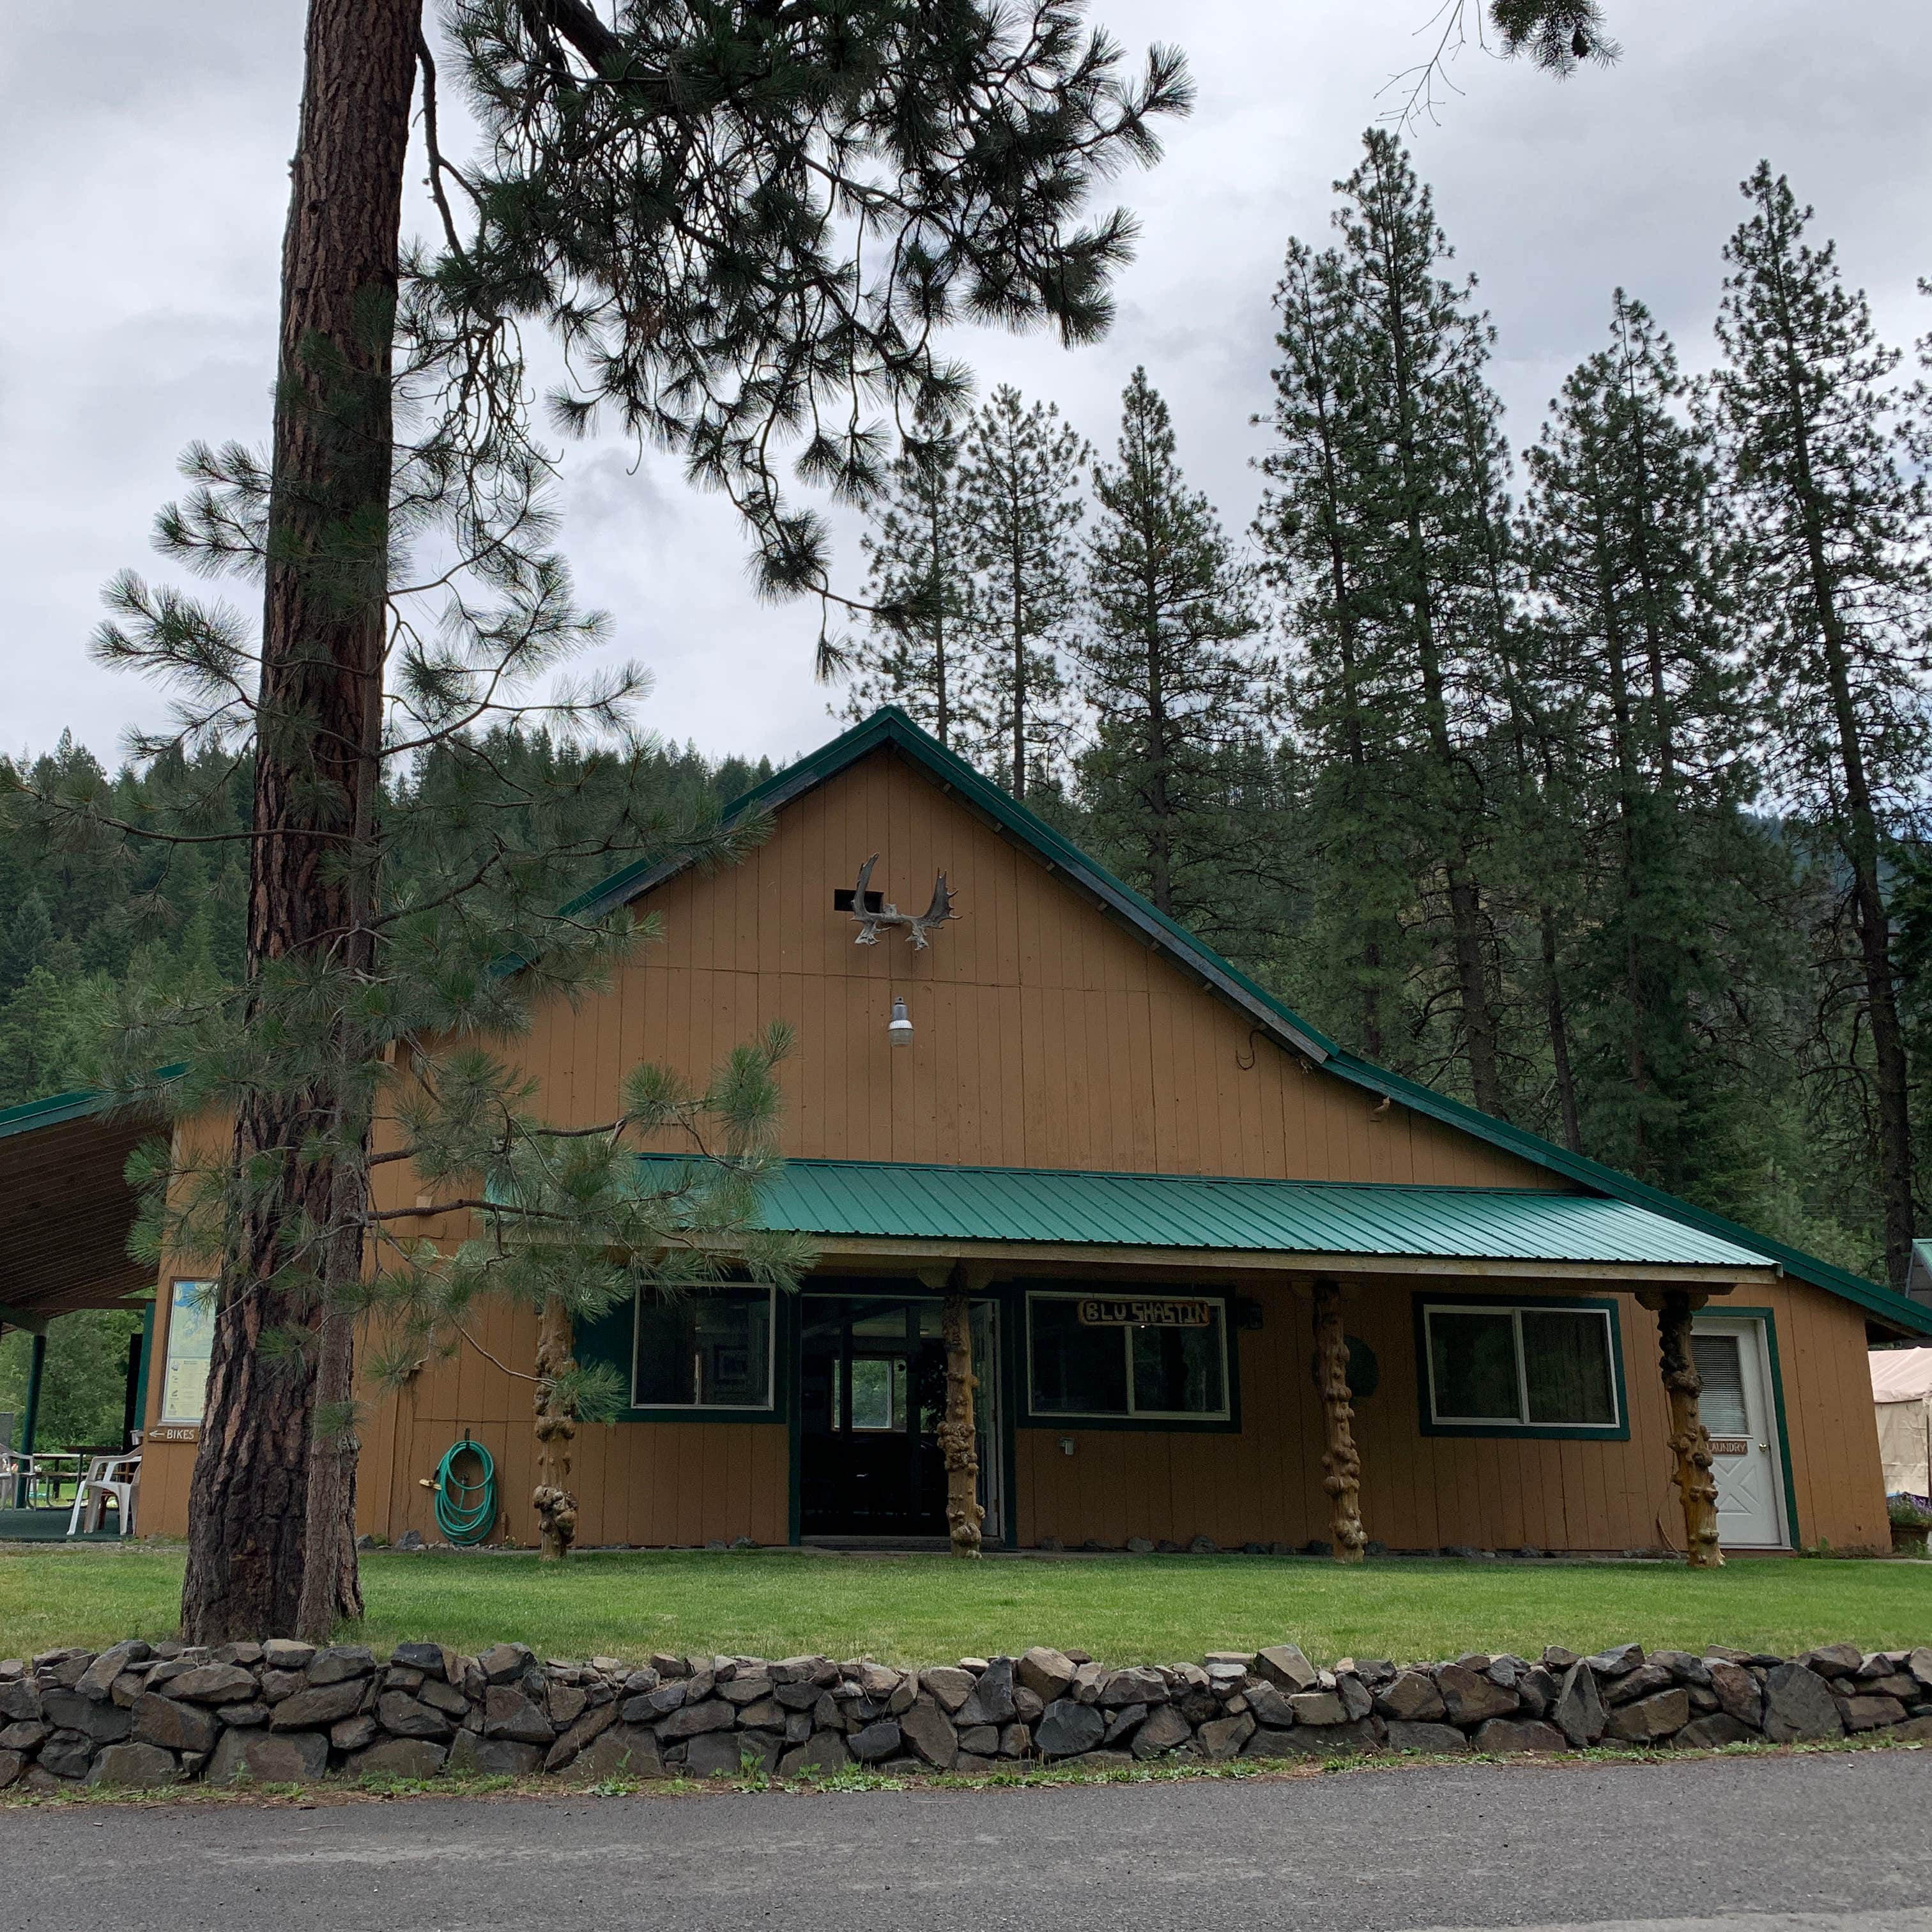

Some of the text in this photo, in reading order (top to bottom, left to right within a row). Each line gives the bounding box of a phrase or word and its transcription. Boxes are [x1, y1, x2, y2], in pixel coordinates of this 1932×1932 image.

[1085, 1302, 1207, 1324] BLU SHASTIN
[167, 1429, 195, 1440] BIKES
[1706, 1442, 1746, 1452] LAUNDRY
